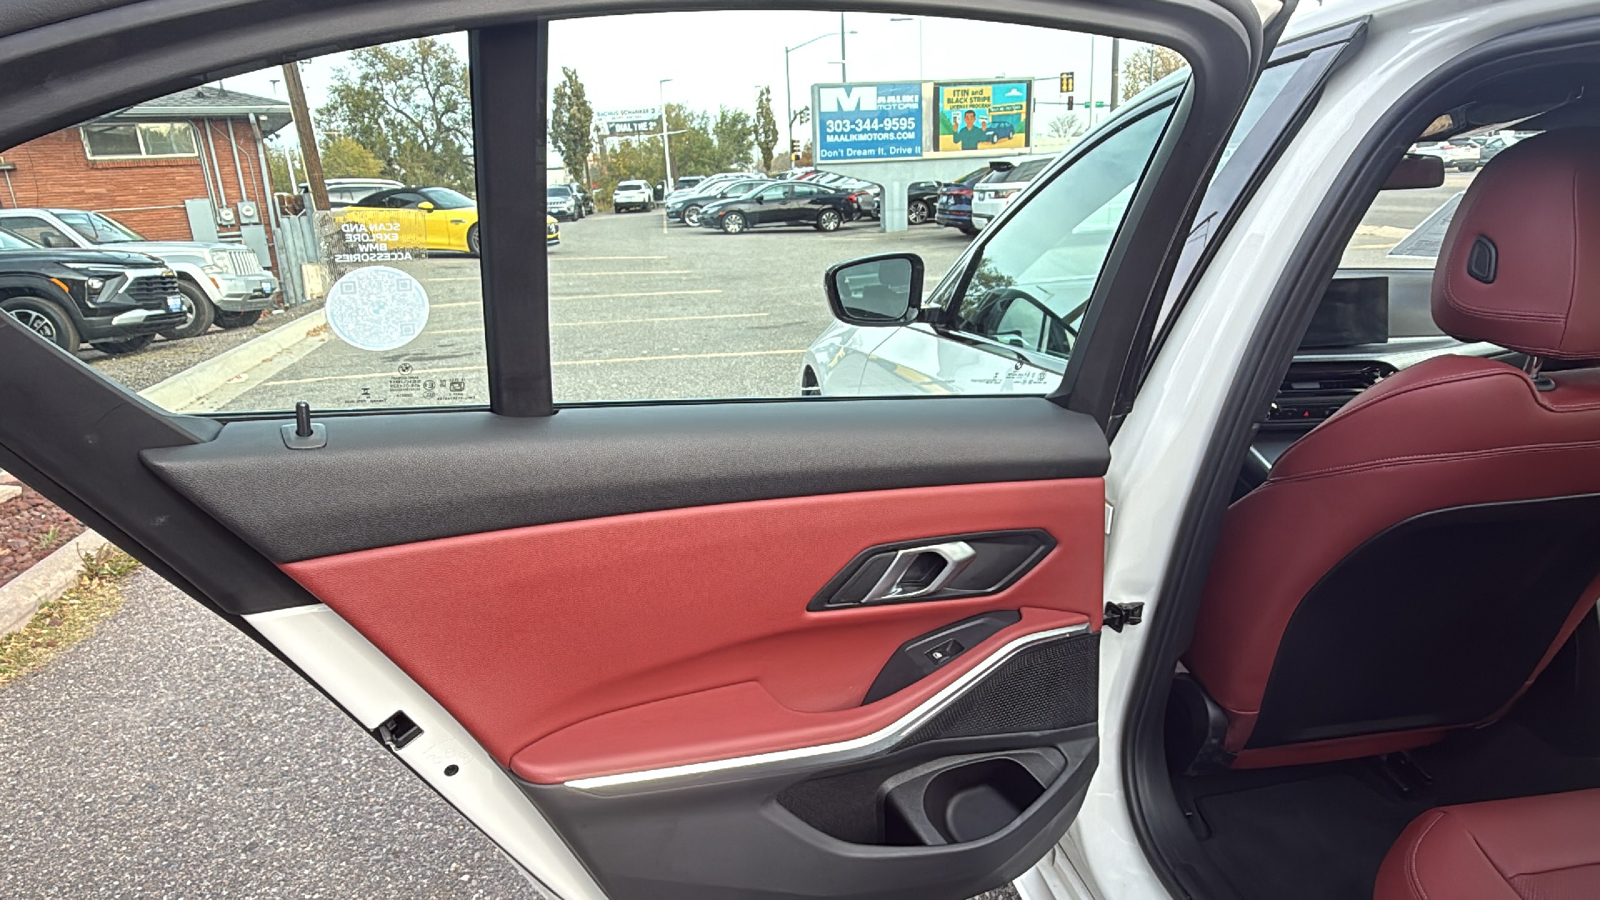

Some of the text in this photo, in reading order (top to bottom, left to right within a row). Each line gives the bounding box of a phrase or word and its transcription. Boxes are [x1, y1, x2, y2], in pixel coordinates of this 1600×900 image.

[953, 89, 970, 97] ITIN
[826, 117, 915, 132] 303-344-9595
[826, 132, 915, 142] MAALIKIMOTORS.COM
[821, 148, 844, 157] Don't
[846, 147, 875, 156] Dream
[889, 145, 912, 154] Drive
